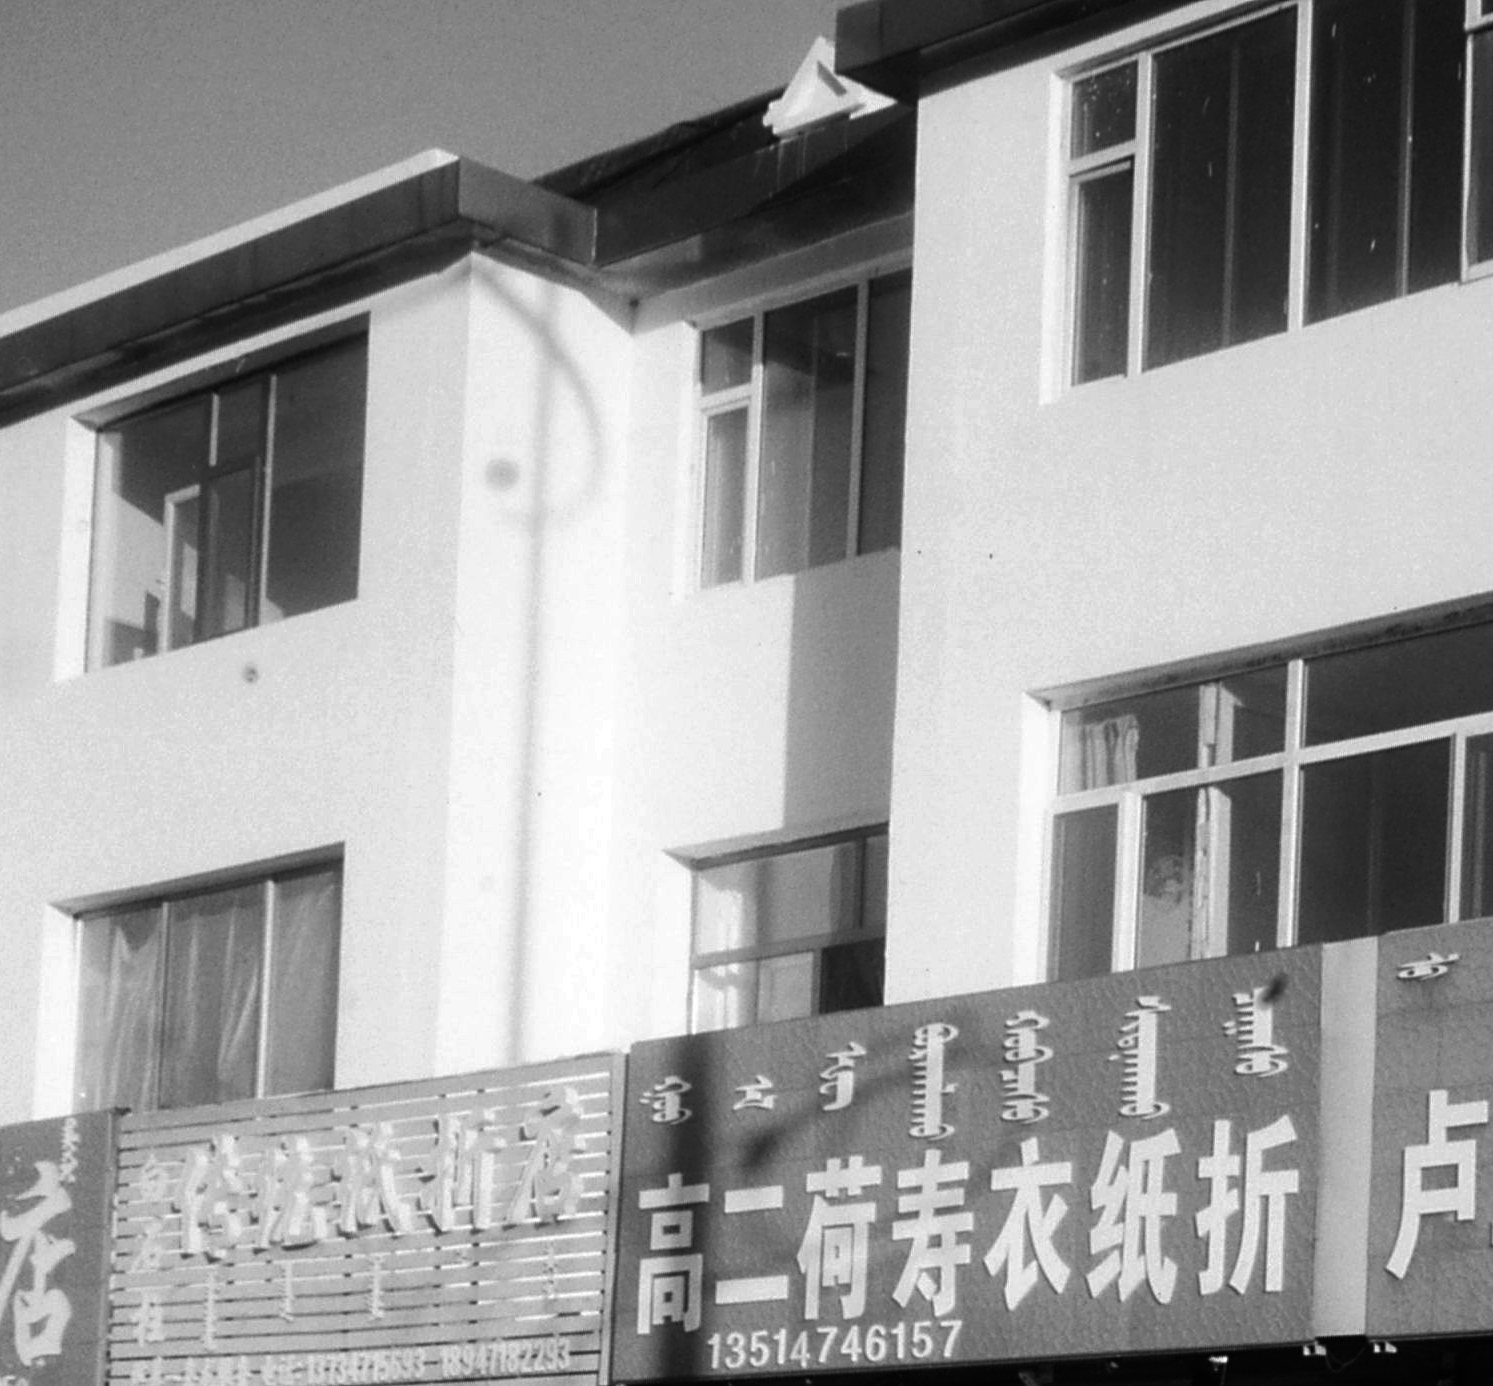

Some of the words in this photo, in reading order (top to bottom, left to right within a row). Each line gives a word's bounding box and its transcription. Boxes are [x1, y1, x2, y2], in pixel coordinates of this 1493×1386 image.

[636, 1115, 1299, 1334] 高二荷寿衣纸折
[708, 1319, 963, 1370] 13514746157
